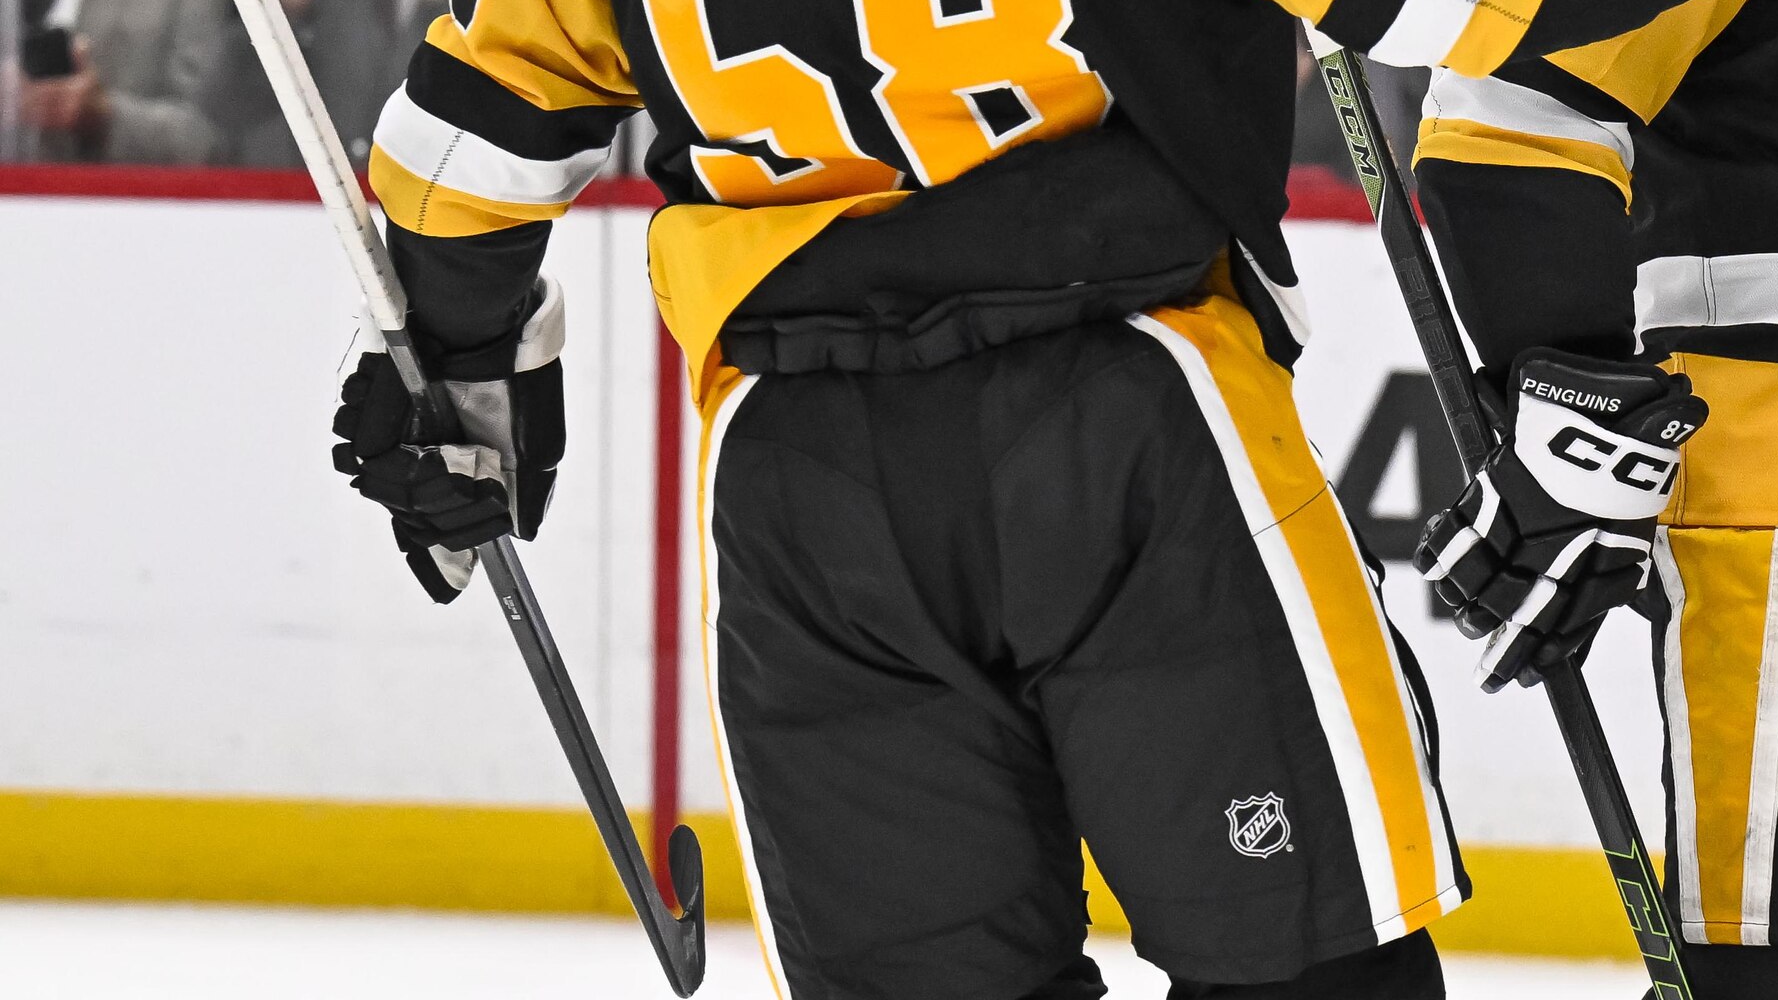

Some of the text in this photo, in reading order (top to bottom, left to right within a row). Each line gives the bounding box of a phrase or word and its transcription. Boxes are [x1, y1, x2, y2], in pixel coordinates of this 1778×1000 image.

[1324, 62, 1381, 179] CCM
[1521, 378, 1622, 413] PENGUINS
[1660, 420, 1696, 443] 87
